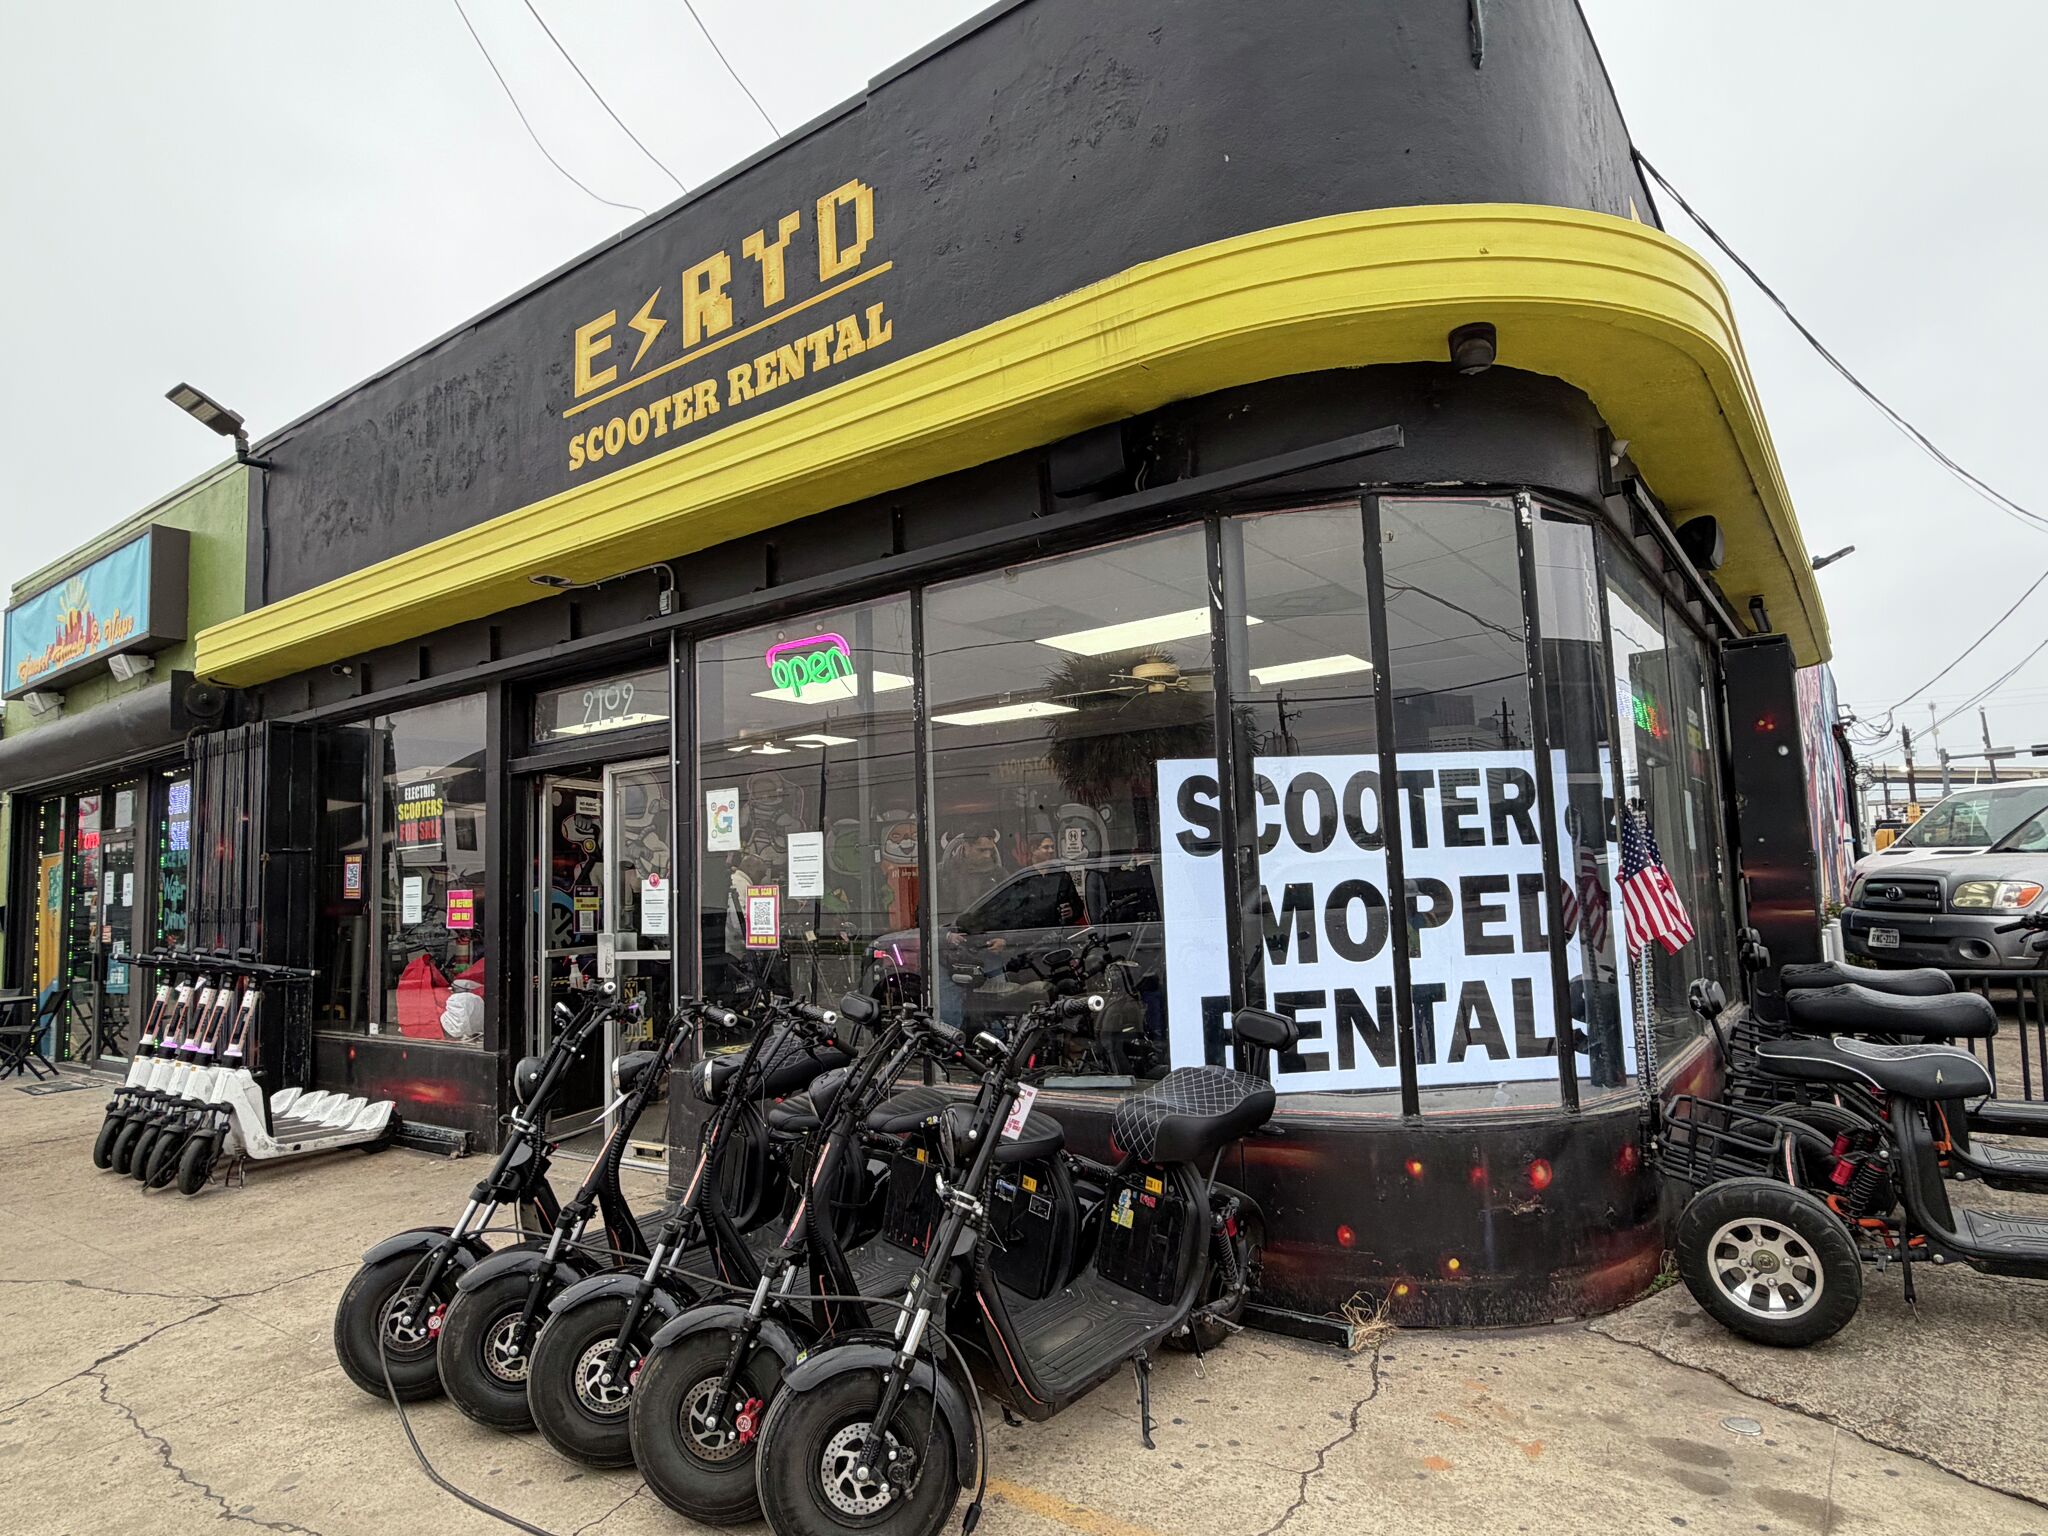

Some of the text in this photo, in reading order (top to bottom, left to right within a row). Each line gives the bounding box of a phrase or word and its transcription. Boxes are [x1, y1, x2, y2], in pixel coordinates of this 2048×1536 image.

[568, 302, 893, 472] SCOOTER RENTAL
[771, 646, 854, 697] open
[398, 797, 443, 821] SCOOTERS
[404, 783, 436, 801] ELECTRIC
[400, 822, 418, 842] FOR
[1262, 873, 1577, 965] MOPED
